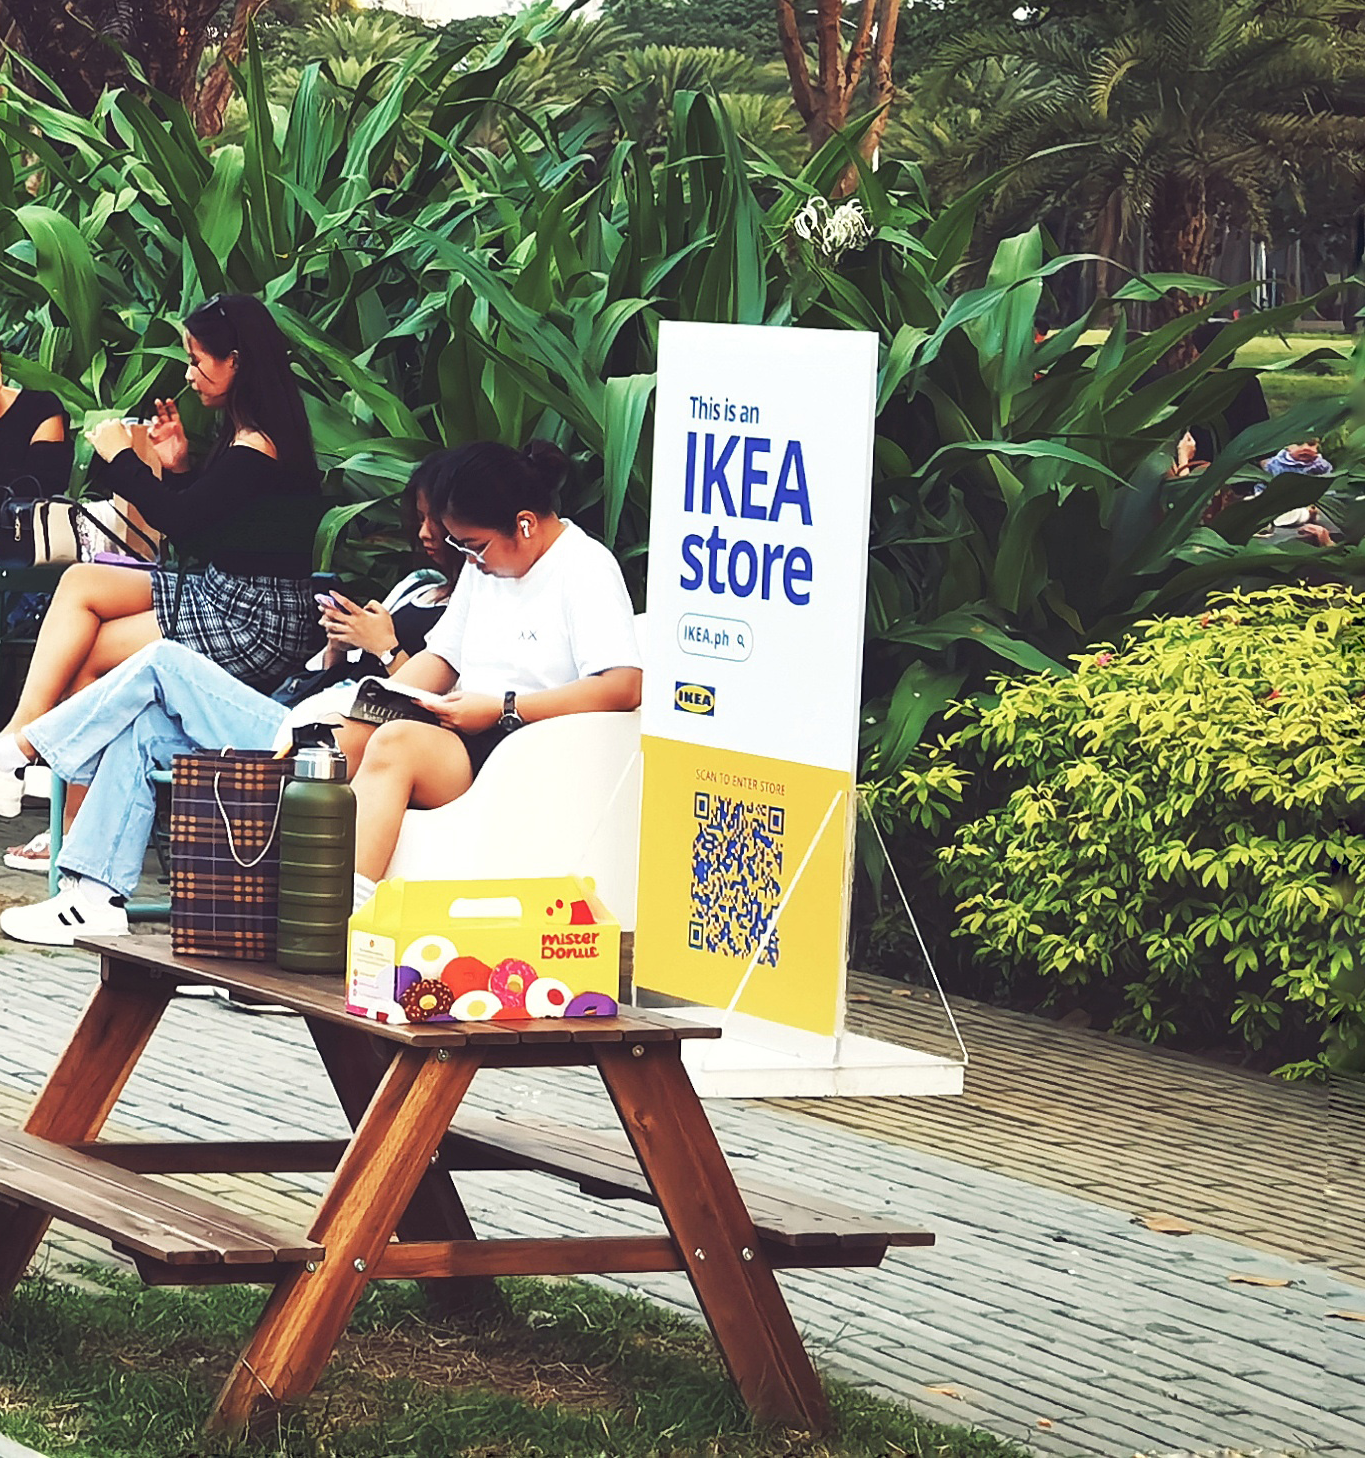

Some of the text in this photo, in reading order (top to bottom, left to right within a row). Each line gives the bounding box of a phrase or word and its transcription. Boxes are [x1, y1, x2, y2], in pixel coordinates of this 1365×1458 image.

[690, 395, 759, 424] This is an
[684, 432, 813, 526] IKEA
[680, 526, 813, 606] store
[684, 625, 729, 650] IKEA.ph
[678, 690, 711, 707] IKEA
[695, 768, 786, 796] SCAN TO ENTER STORE
